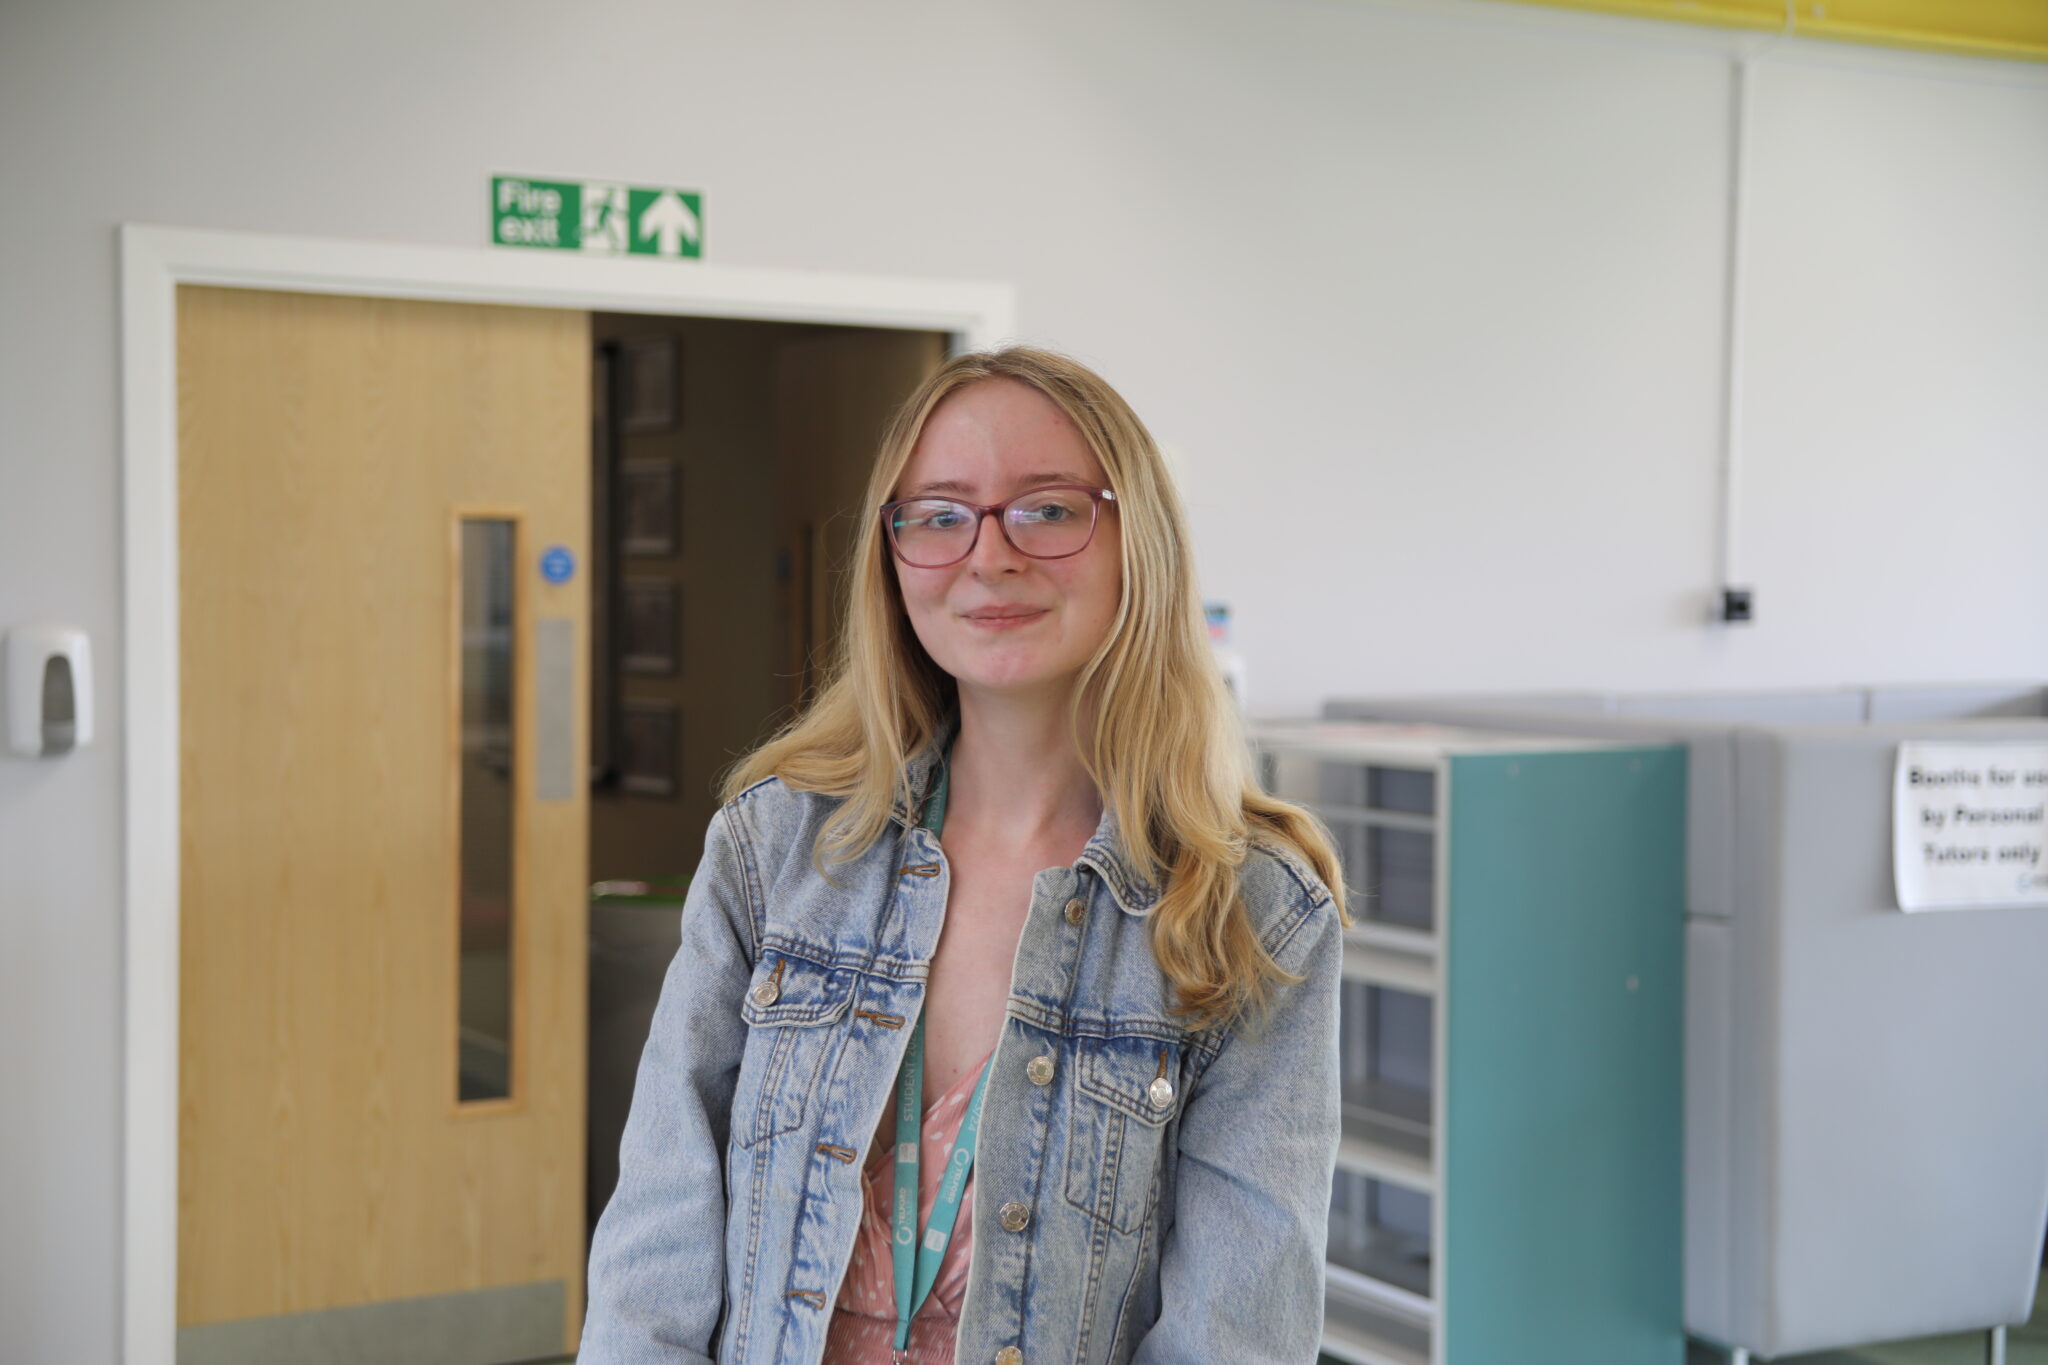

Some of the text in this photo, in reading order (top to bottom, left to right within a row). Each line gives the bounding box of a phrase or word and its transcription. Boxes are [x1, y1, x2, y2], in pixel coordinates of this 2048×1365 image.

[499, 181, 562, 216] Fire
[498, 216, 560, 245] exit
[1909, 766, 2048, 786] Booths for us
[1921, 804, 2043, 831] by Personal
[1924, 840, 2041, 867] Tutors only
[903, 1061, 917, 1122] STUDENT
[898, 1188, 906, 1225] TELFORD
